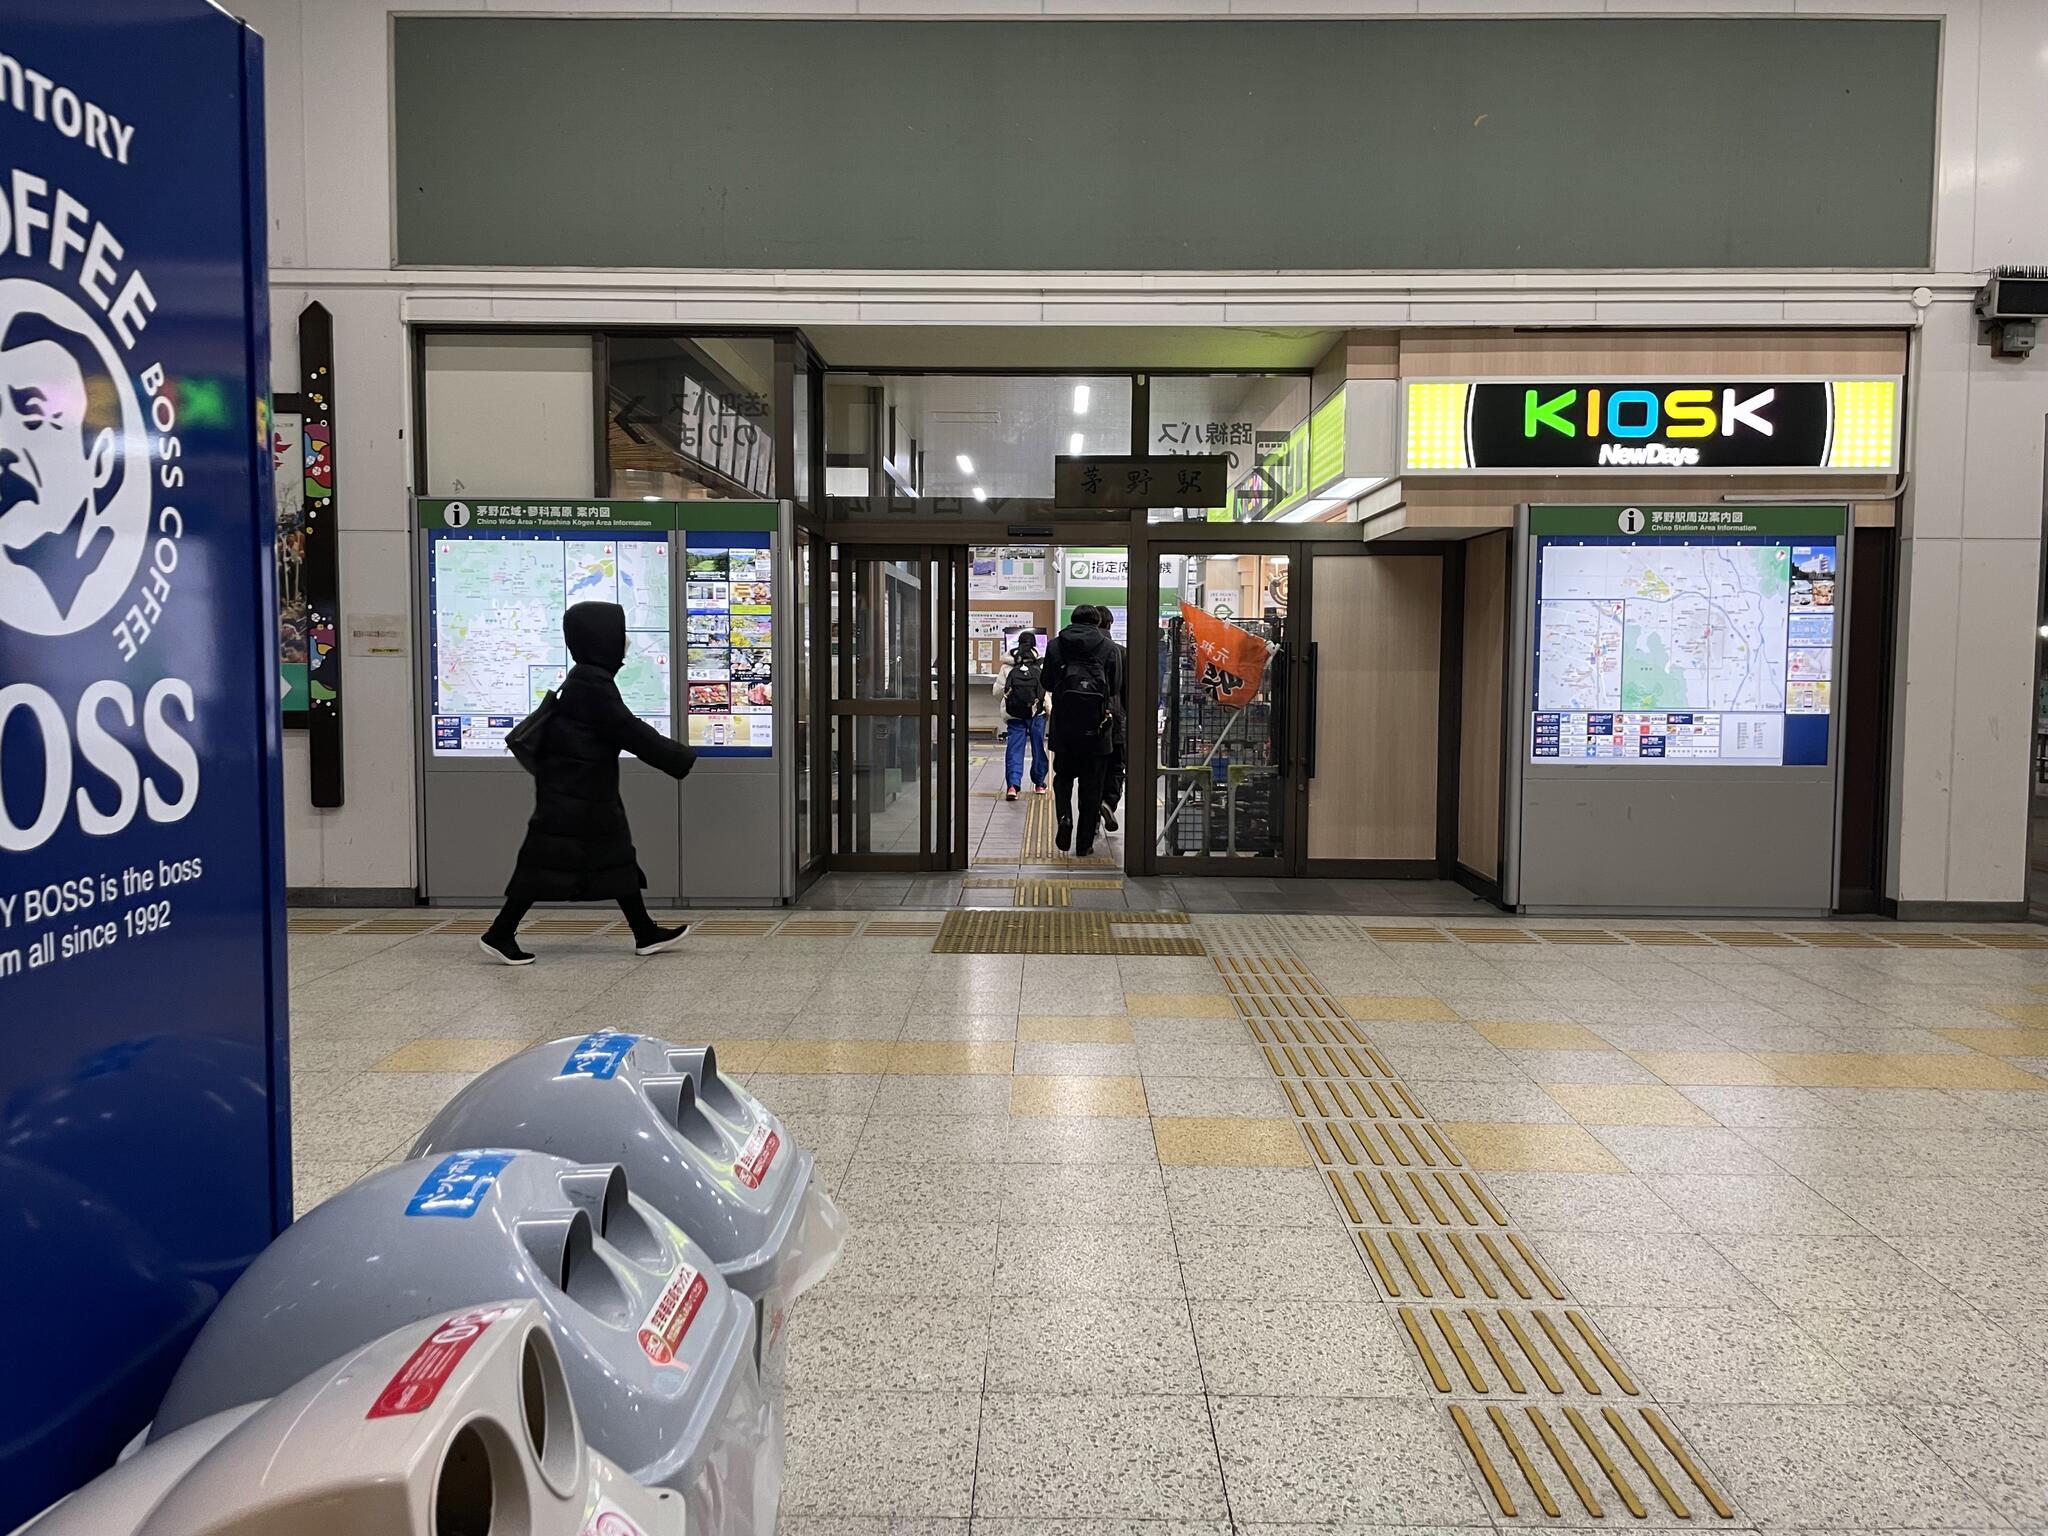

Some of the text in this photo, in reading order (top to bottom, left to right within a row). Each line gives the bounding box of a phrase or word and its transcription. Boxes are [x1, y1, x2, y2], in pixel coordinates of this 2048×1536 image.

[0, 169, 157, 350] FFEE
[140, 362, 183, 488] BOSS
[1525, 388, 1775, 438] KIOSK
[1599, 444, 1700, 466] NewDays
[577, 507, 611, 518] 案内図
[1652, 511, 1743, 523] 茅野駅周辺案内図
[112, 507, 183, 662] COFFEE
[24, 877, 95, 922] BOSS
[100, 873, 118, 902] is
[123, 867, 154, 896] the
[159, 857, 202, 887] boss
[28, 932, 54, 968] all
[62, 925, 117, 958] since
[124, 900, 171, 938] 1992
